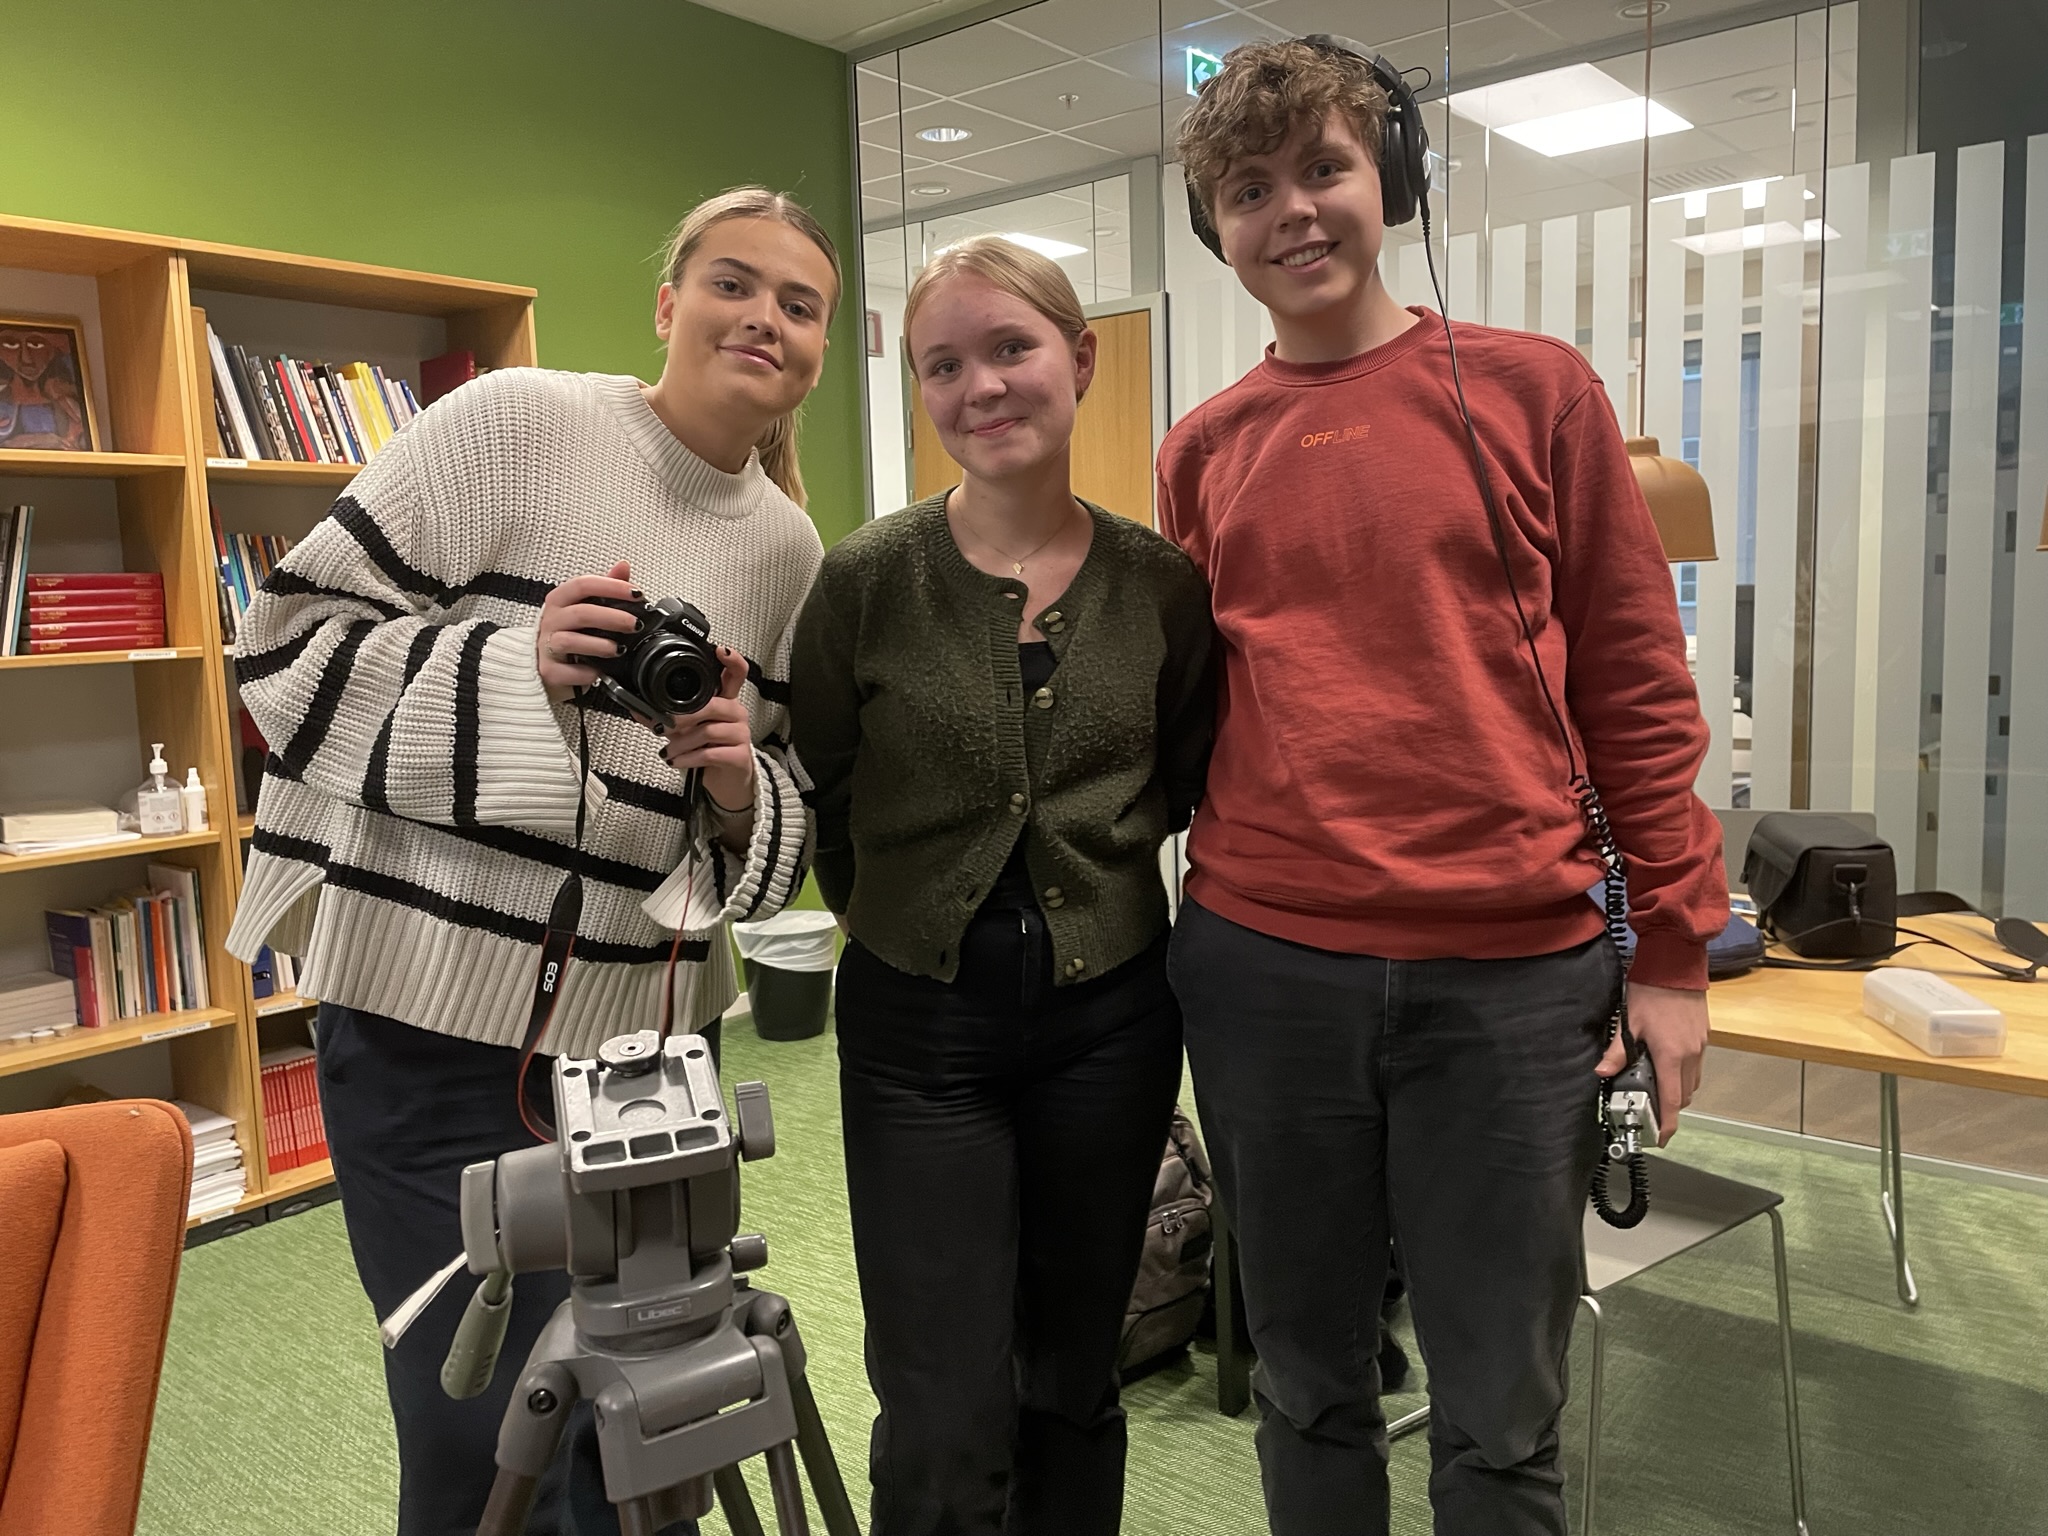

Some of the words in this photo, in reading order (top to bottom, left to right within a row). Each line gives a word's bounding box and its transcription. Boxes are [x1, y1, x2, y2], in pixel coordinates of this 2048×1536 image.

[1300, 424, 1371, 448] OFFLINE
[681, 618, 705, 638] Canon
[543, 961, 558, 993] EOS
